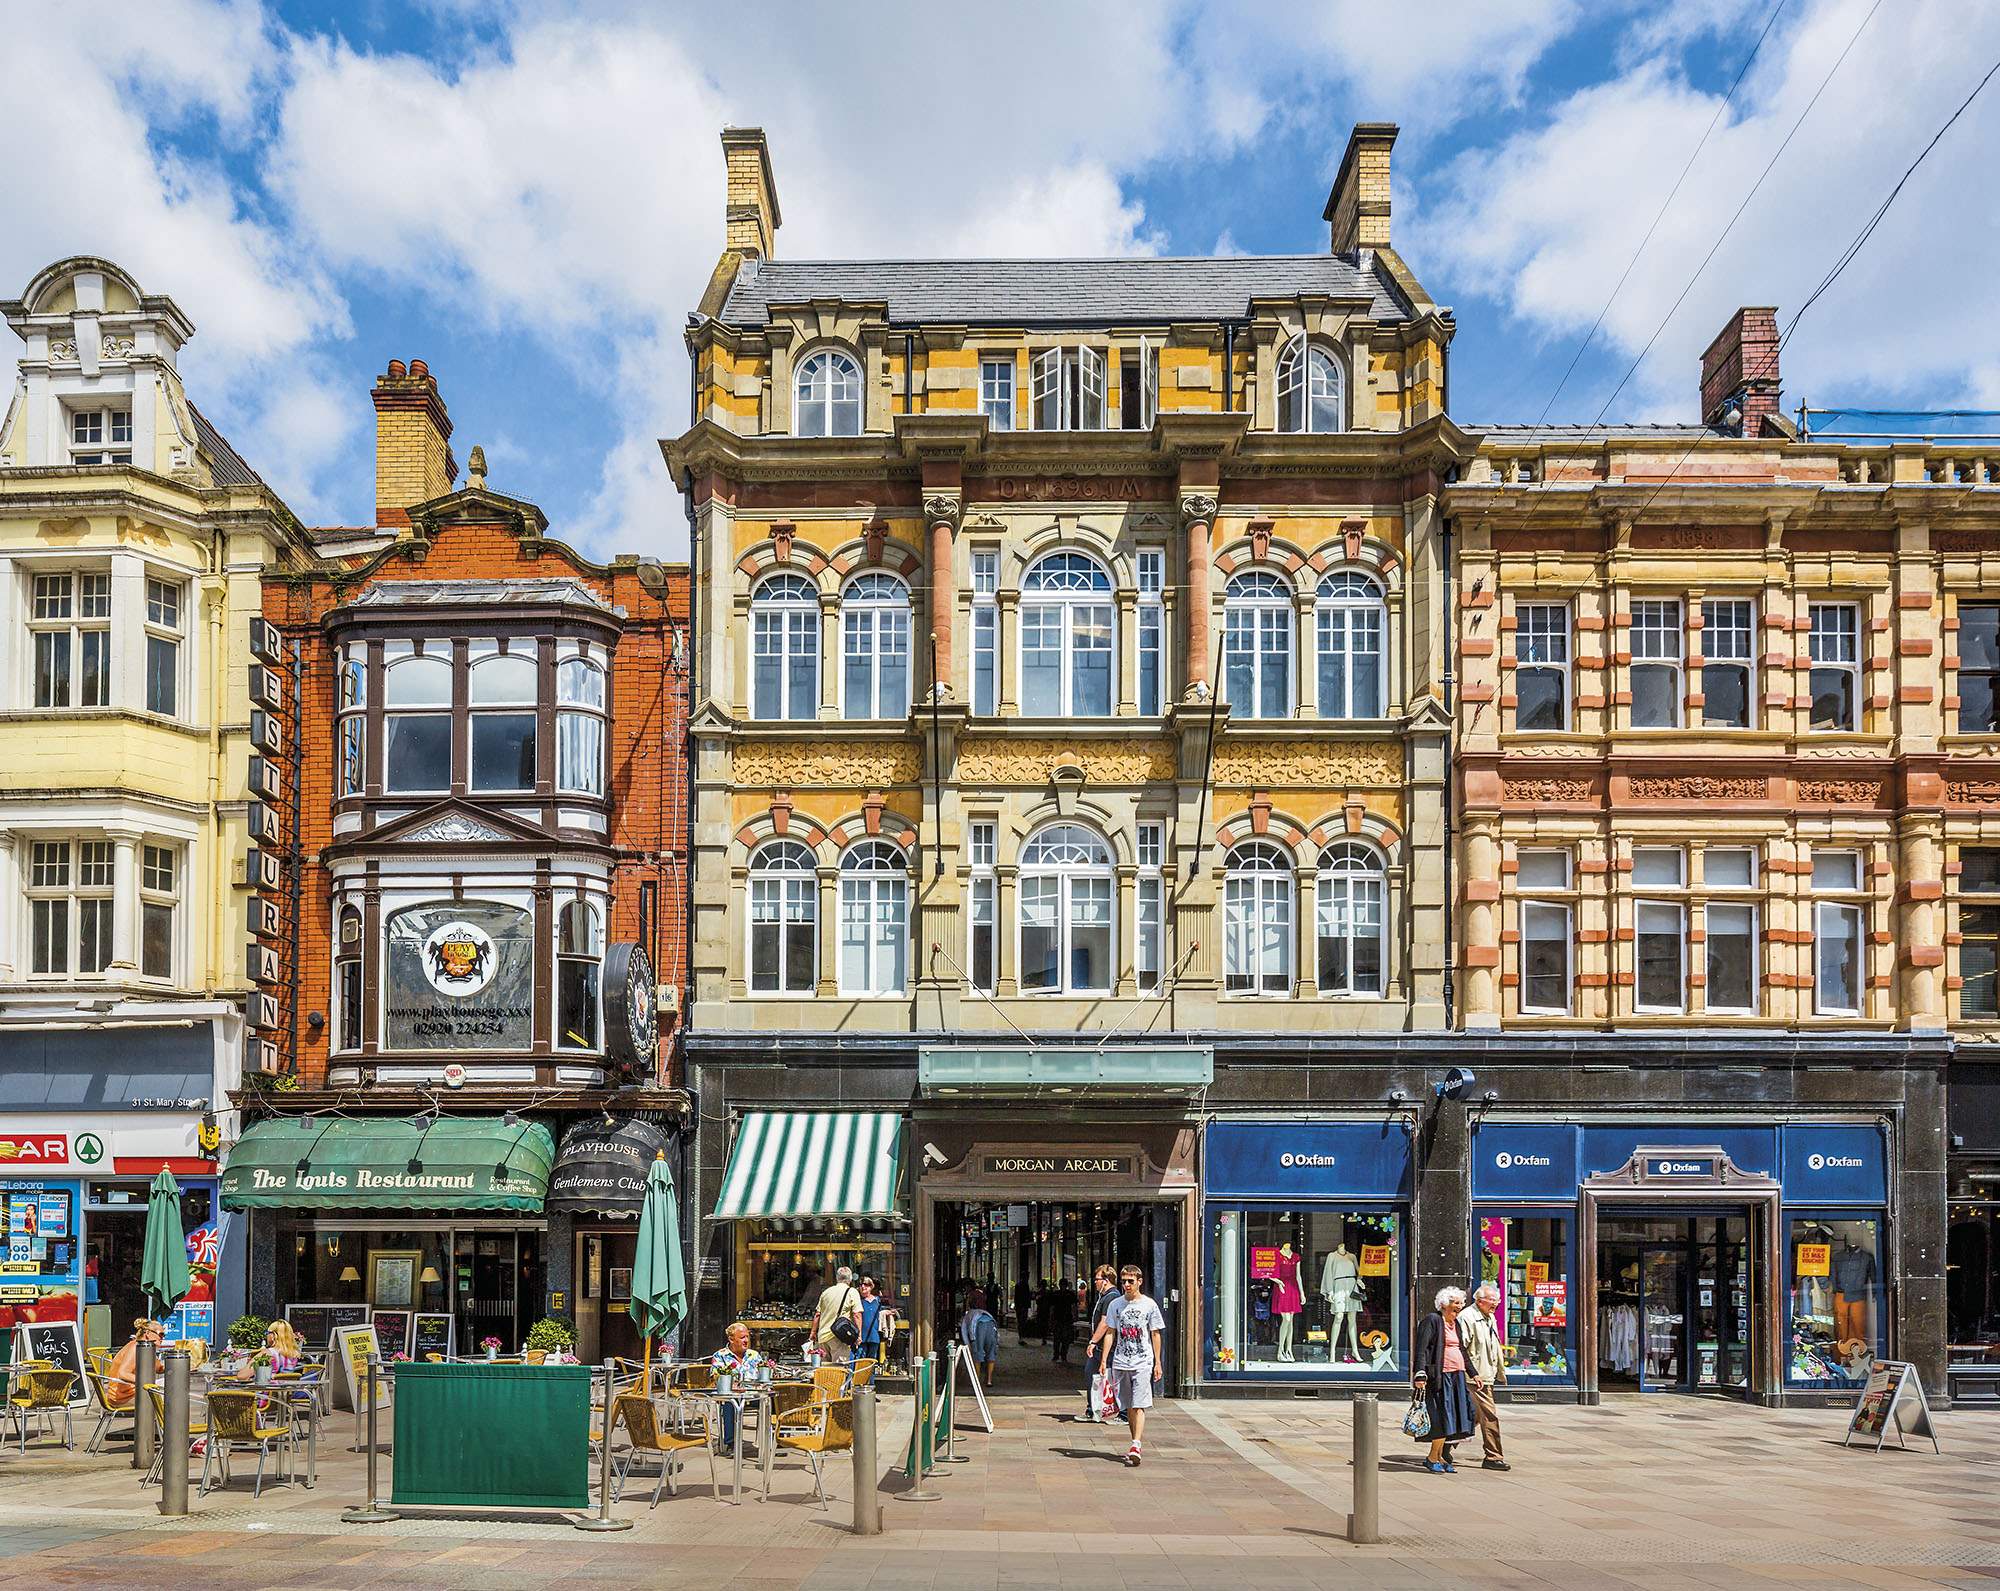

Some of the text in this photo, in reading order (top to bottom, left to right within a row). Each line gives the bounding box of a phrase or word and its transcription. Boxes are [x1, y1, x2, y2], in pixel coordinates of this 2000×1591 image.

[263, 625, 279, 1071] RESTAURANT
[413, 1022, 504, 1036] 02920 224254
[132, 1098, 141, 1107] 31
[143, 1098, 154, 1107] St.
[156, 1098, 175, 1108] Mary
[563, 1142, 640, 1158] PLAYHOUSE
[995, 1159, 1119, 1171] MORGAN ARCADE
[1295, 1154, 1335, 1166] Oxfam
[1514, 1154, 1550, 1166] Oxfam
[1826, 1156, 1863, 1167] Oxfam
[1672, 1163, 1701, 1172] Oxfam
[8, 1181, 44, 1190] Lebara
[253, 1169, 475, 1190] The Louis Restaurant
[489, 1176, 531, 1186] Restaurant
[554, 1175, 647, 1192] Gentlemens Club
[496, 1184, 522, 1193] Coffee
[522, 1186, 538, 1194] Shop
[43, 1329, 55, 1343] 2
[36, 1341, 69, 1356] MEALS
